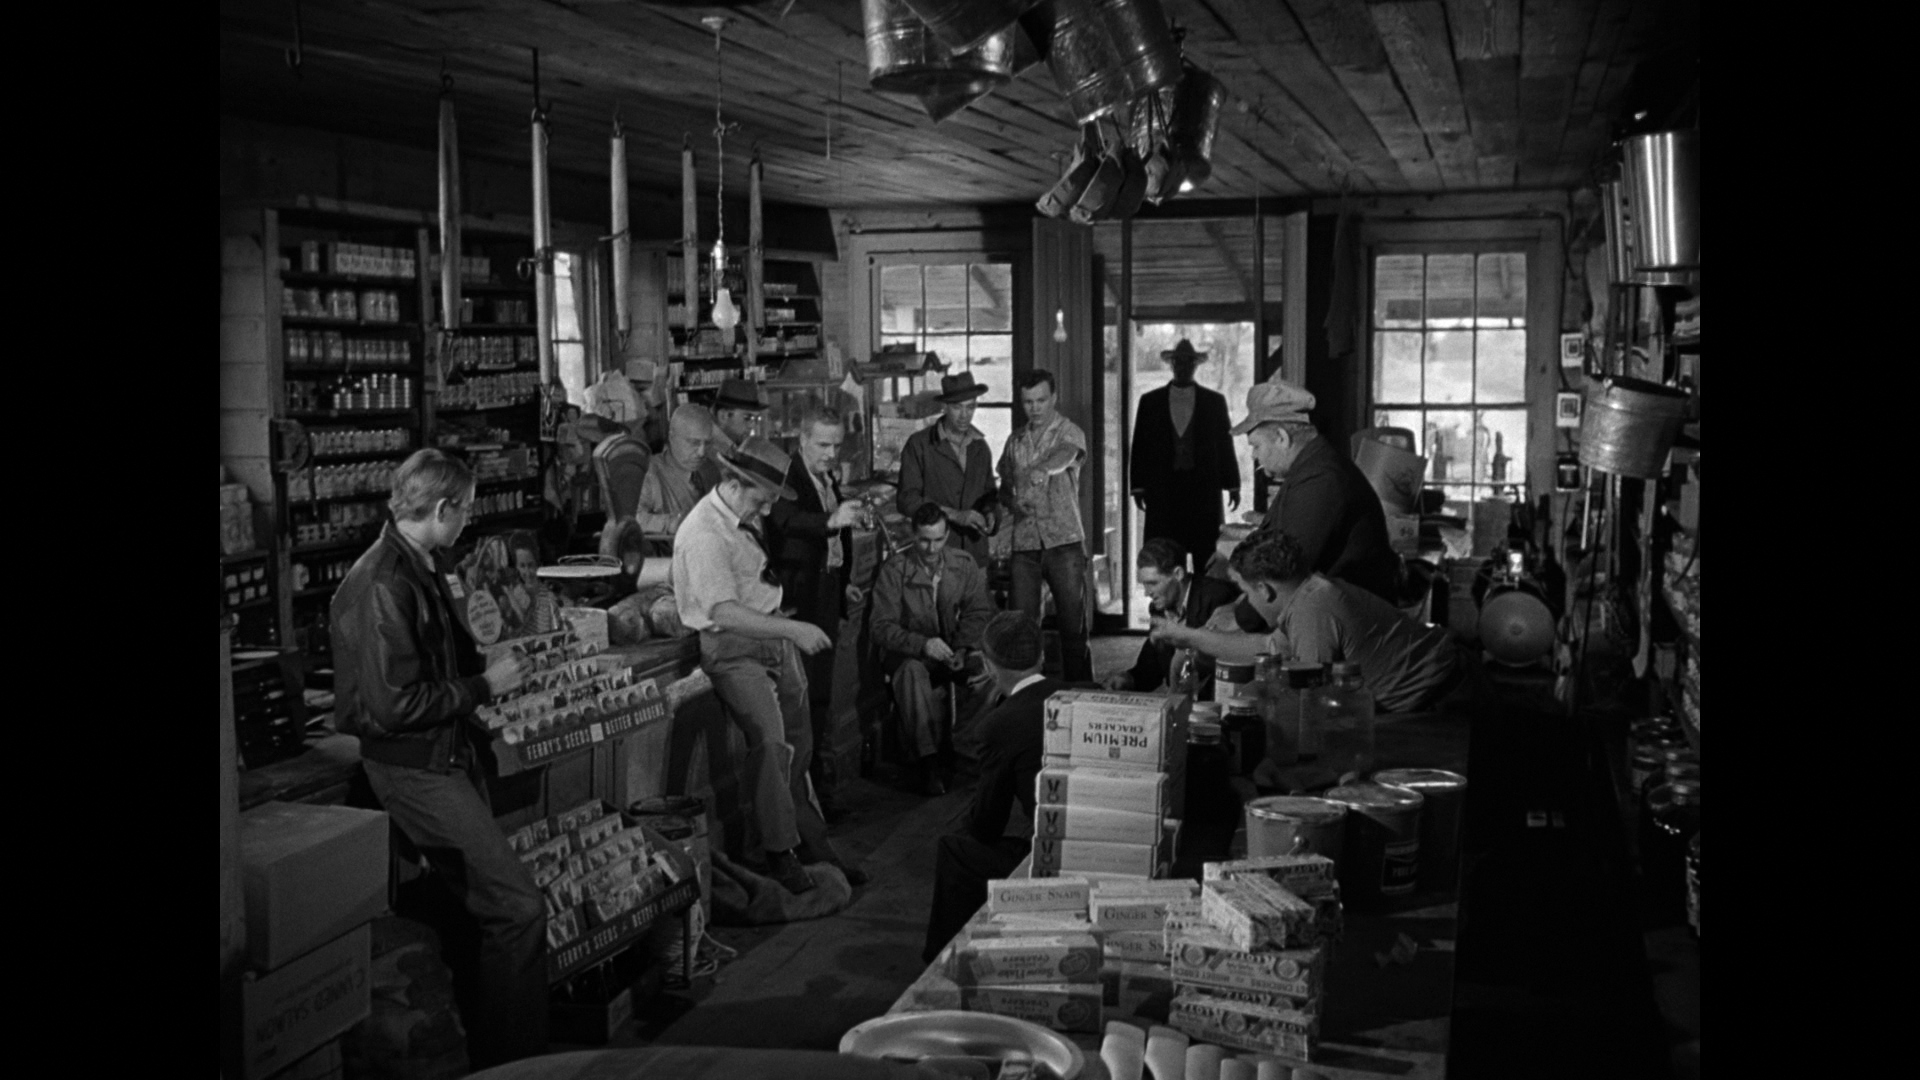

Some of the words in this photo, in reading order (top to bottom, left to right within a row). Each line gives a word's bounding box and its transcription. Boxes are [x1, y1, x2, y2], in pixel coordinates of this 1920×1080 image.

[605, 714, 632, 736] BETTER
[634, 702, 665, 726] GARDENS
[1088, 722, 1144, 734] CRACKERS
[526, 736, 563, 760] FERRY'S
[565, 728, 591, 750] SEEDS
[1083, 732, 1148, 749] PREMIUM
[1000, 890, 1042, 903] GINGER
[1048, 889, 1081, 901] SNAPS
[1104, 906, 1148, 920] GINGER
[557, 940, 591, 970] FERRY'S
[593, 925, 619, 950] SEEDS
[632, 903, 659, 928] BETTER
